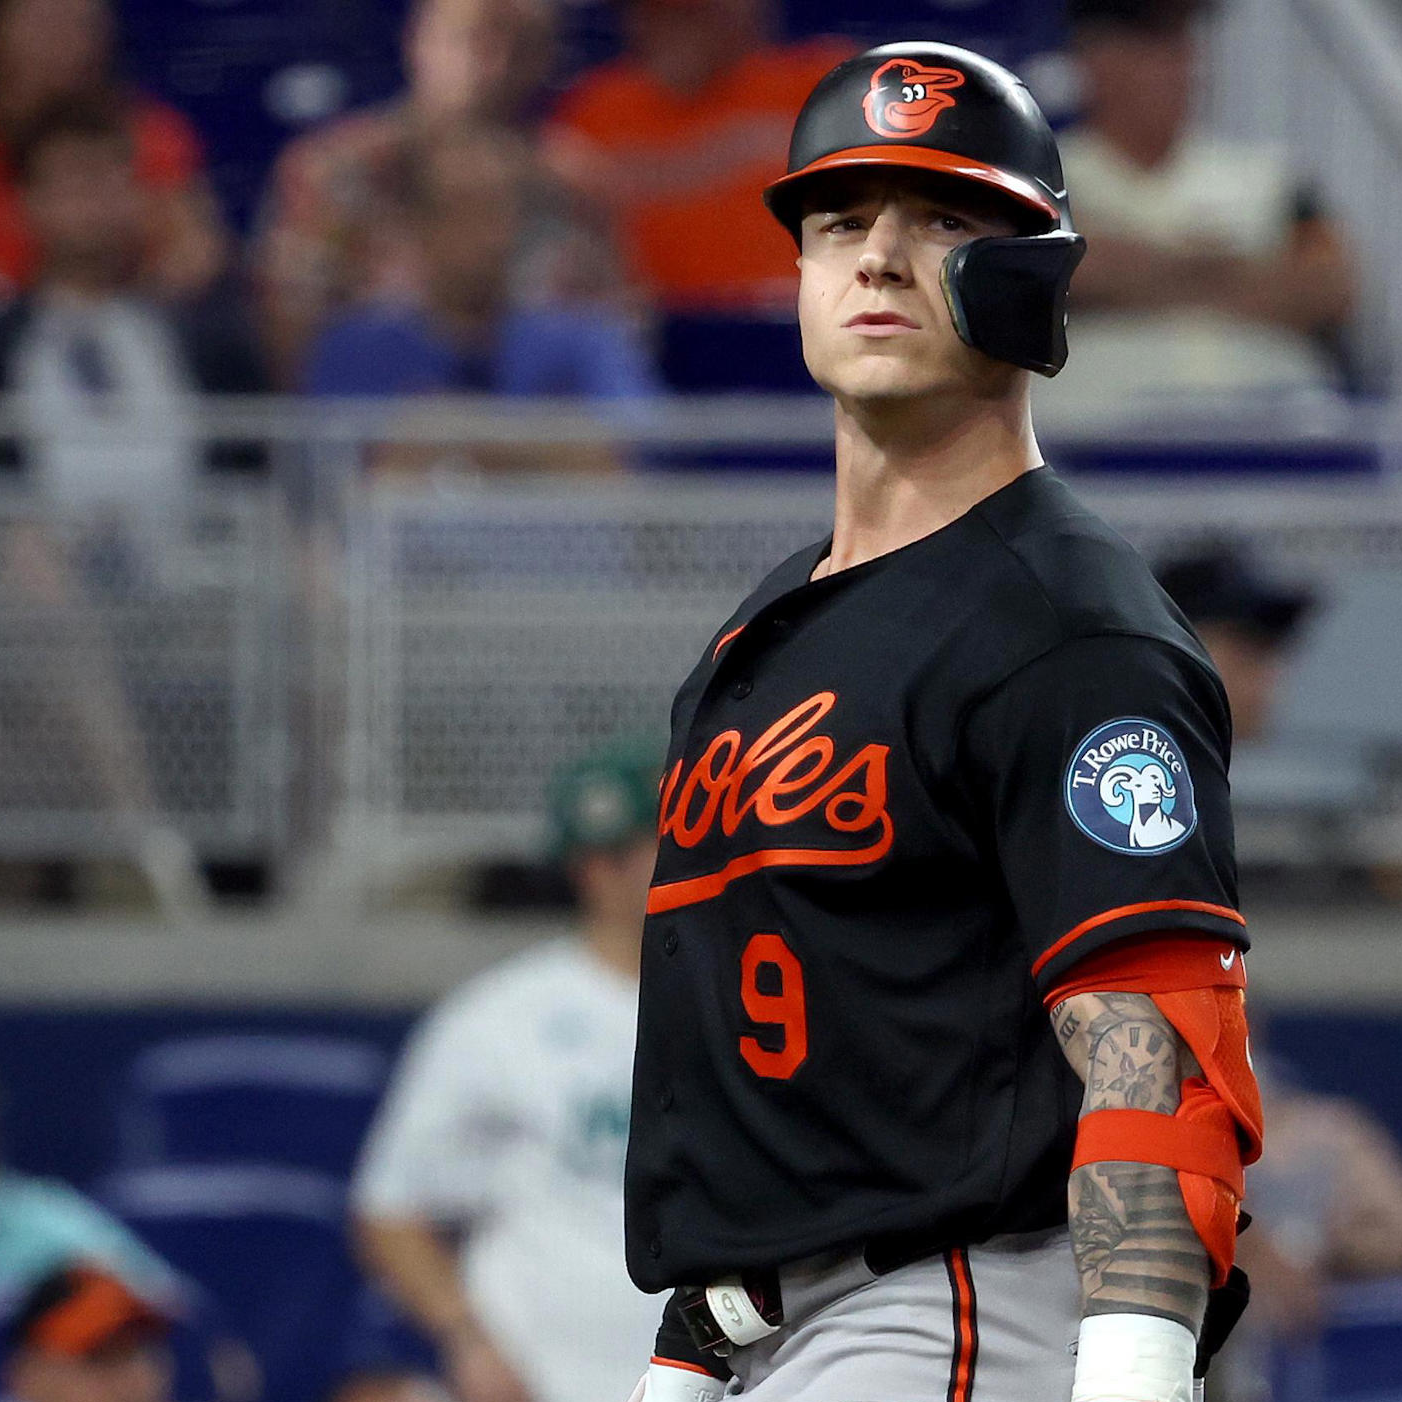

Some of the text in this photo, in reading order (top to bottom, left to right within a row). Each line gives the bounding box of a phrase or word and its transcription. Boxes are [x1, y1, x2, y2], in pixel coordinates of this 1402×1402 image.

[658, 690, 891, 849] ioles
[1082, 732, 1141, 773] Rowe
[1141, 728, 1183, 775] Price
[740, 933, 808, 1080] 9
